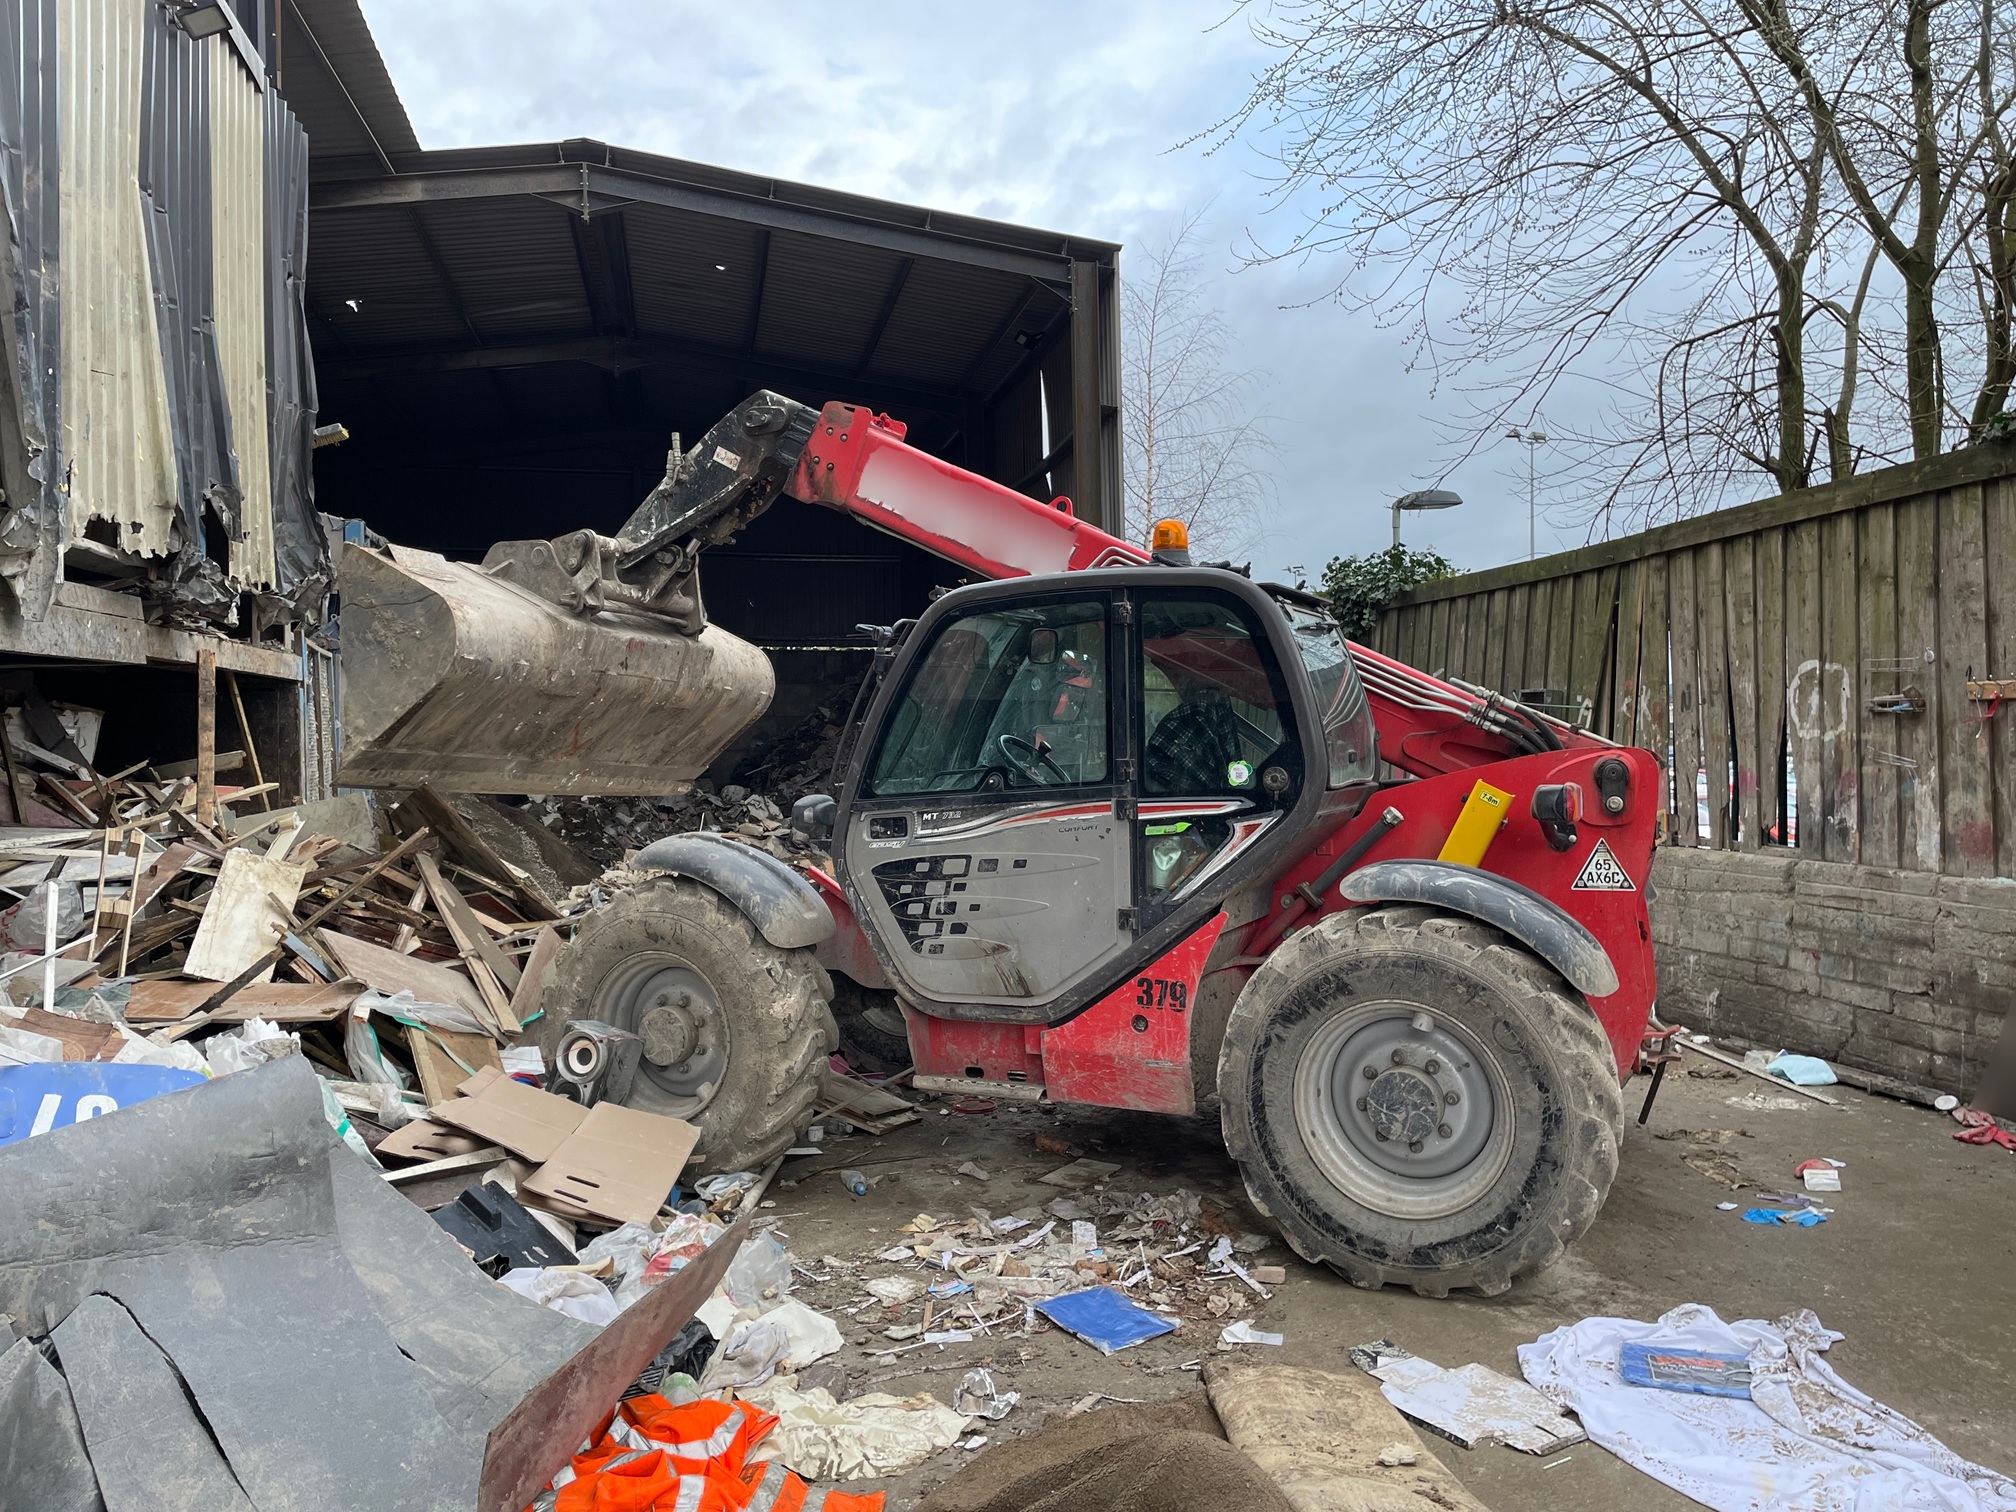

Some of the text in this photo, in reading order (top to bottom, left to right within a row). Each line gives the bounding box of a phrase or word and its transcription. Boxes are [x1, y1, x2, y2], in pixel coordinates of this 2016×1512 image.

[922, 812, 939, 821] MT
[1594, 859, 1611, 871] 65
[1586, 871, 1621, 884] AX6C
[1136, 977, 1187, 1013] 379
